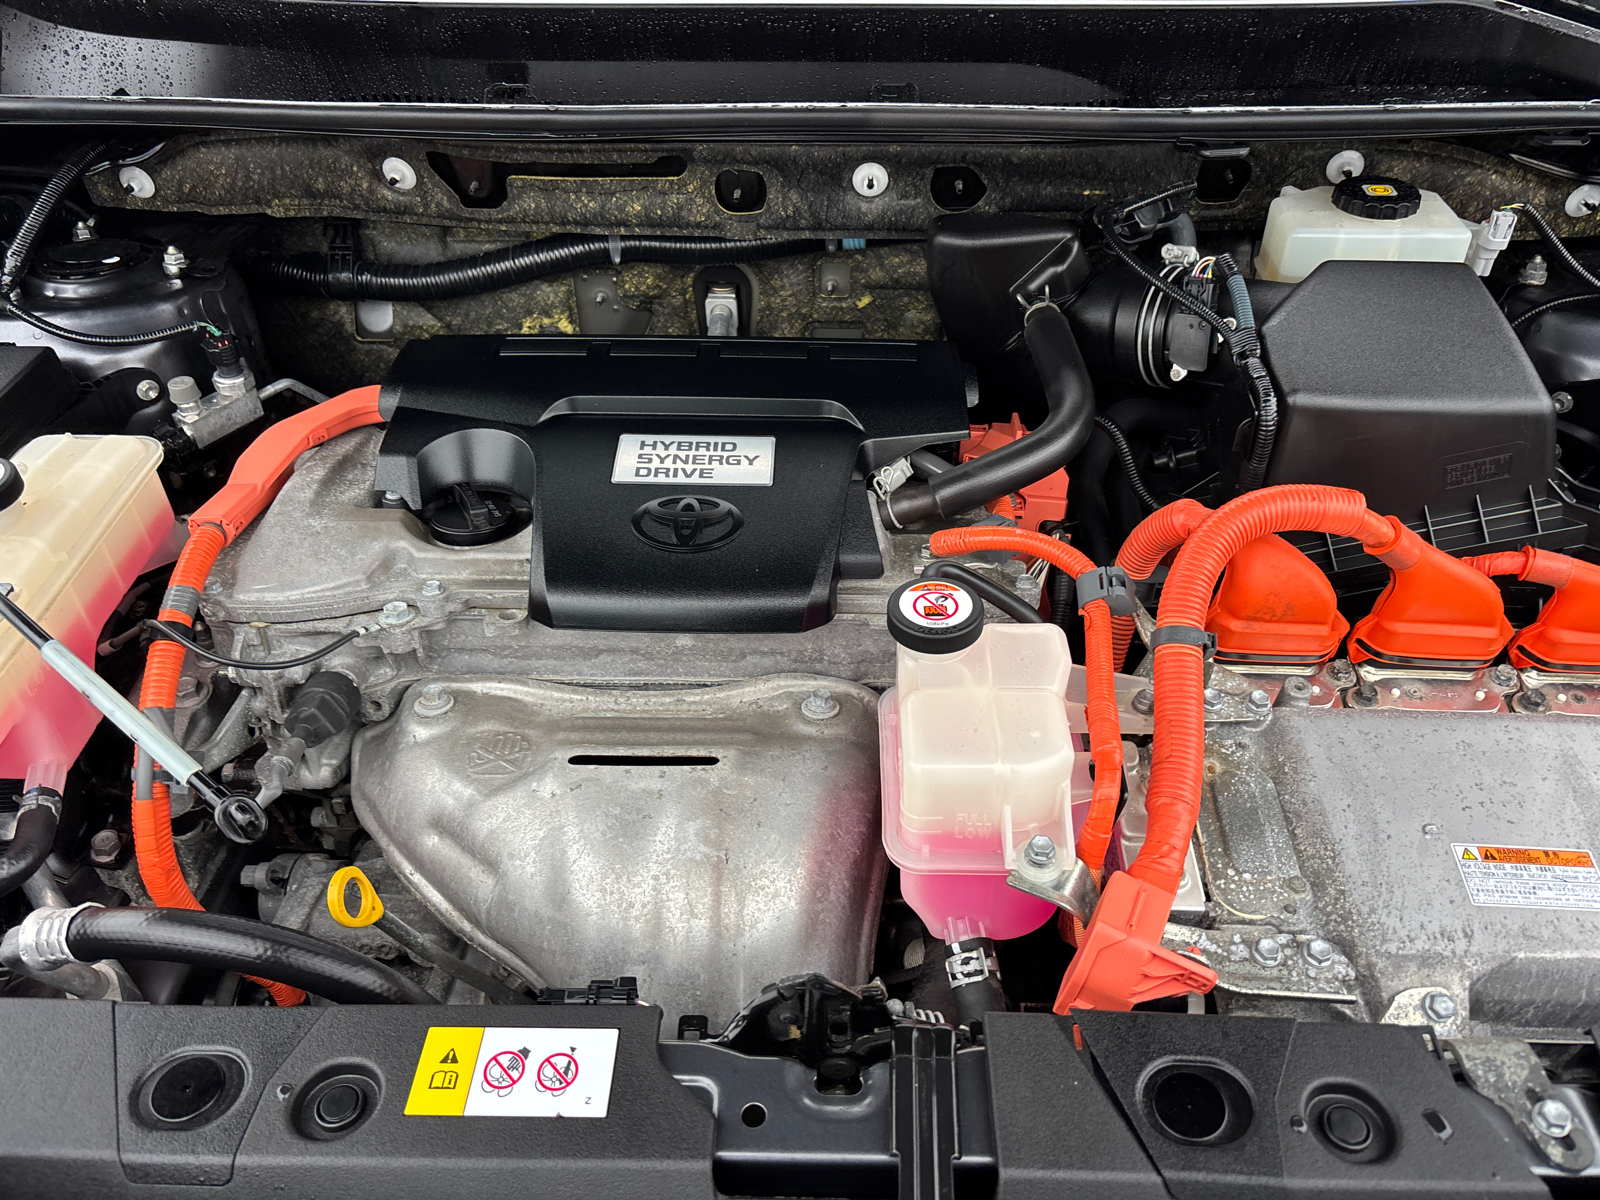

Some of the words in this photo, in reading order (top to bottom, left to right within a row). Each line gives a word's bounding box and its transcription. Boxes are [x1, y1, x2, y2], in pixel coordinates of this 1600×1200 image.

[639, 440, 738, 452] HYBRID
[636, 453, 761, 466] SYNERGY
[634, 466, 715, 479] DRIVE
[915, 625, 959, 635] DENSO
[956, 812, 992, 826] FULL
[954, 826, 993, 840] LOW
[1495, 848, 1531, 858] WARNING
